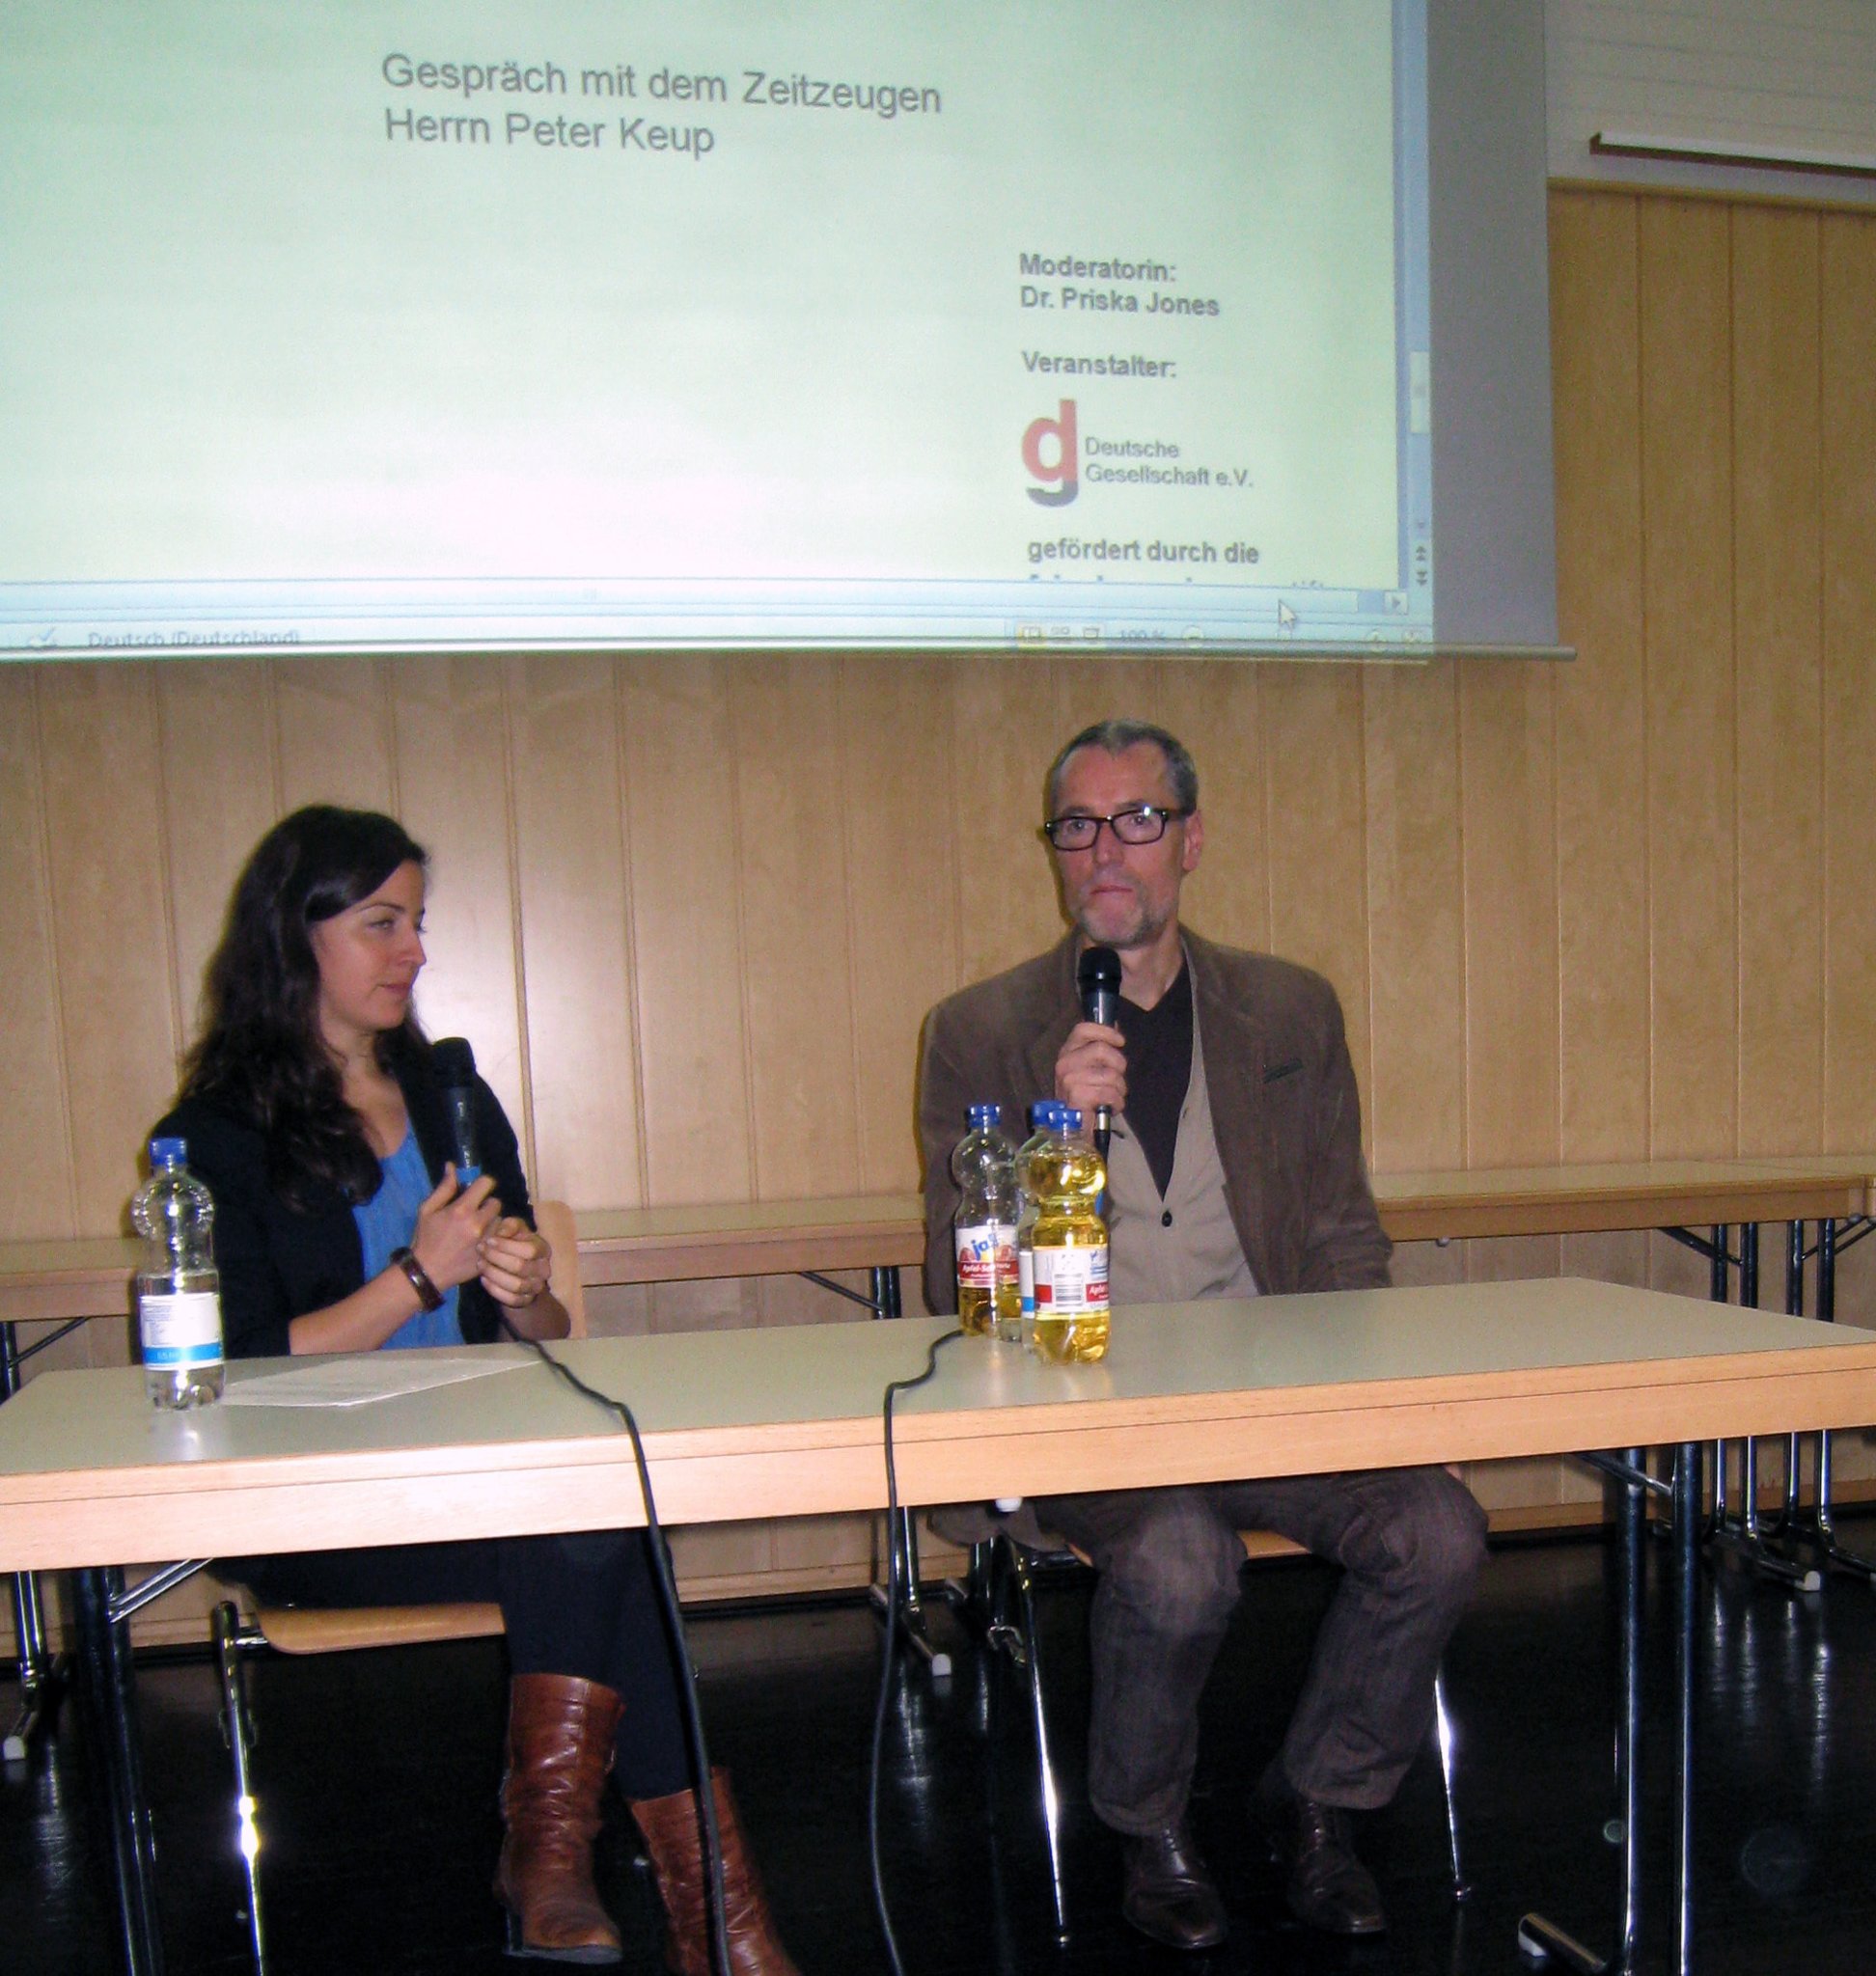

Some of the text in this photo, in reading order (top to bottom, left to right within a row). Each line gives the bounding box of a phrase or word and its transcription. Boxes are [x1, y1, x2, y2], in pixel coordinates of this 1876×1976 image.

[382, 52, 942, 118] Gespräch mit dem Zeitzeugen
[385, 108, 715, 160] Herrn Peter Keup
[1019, 253, 1176, 282] Moderatorin:
[1020, 286, 1221, 317] Dr. Priska Jones
[1022, 350, 1177, 378] Veranstalter:
[1086, 436, 1180, 458] Deutsche
[1085, 463, 1254, 488] Gesellschaft e.V.
[1028, 537, 1259, 564] gefördert durch die
[88, 631, 165, 647] Deutsch
